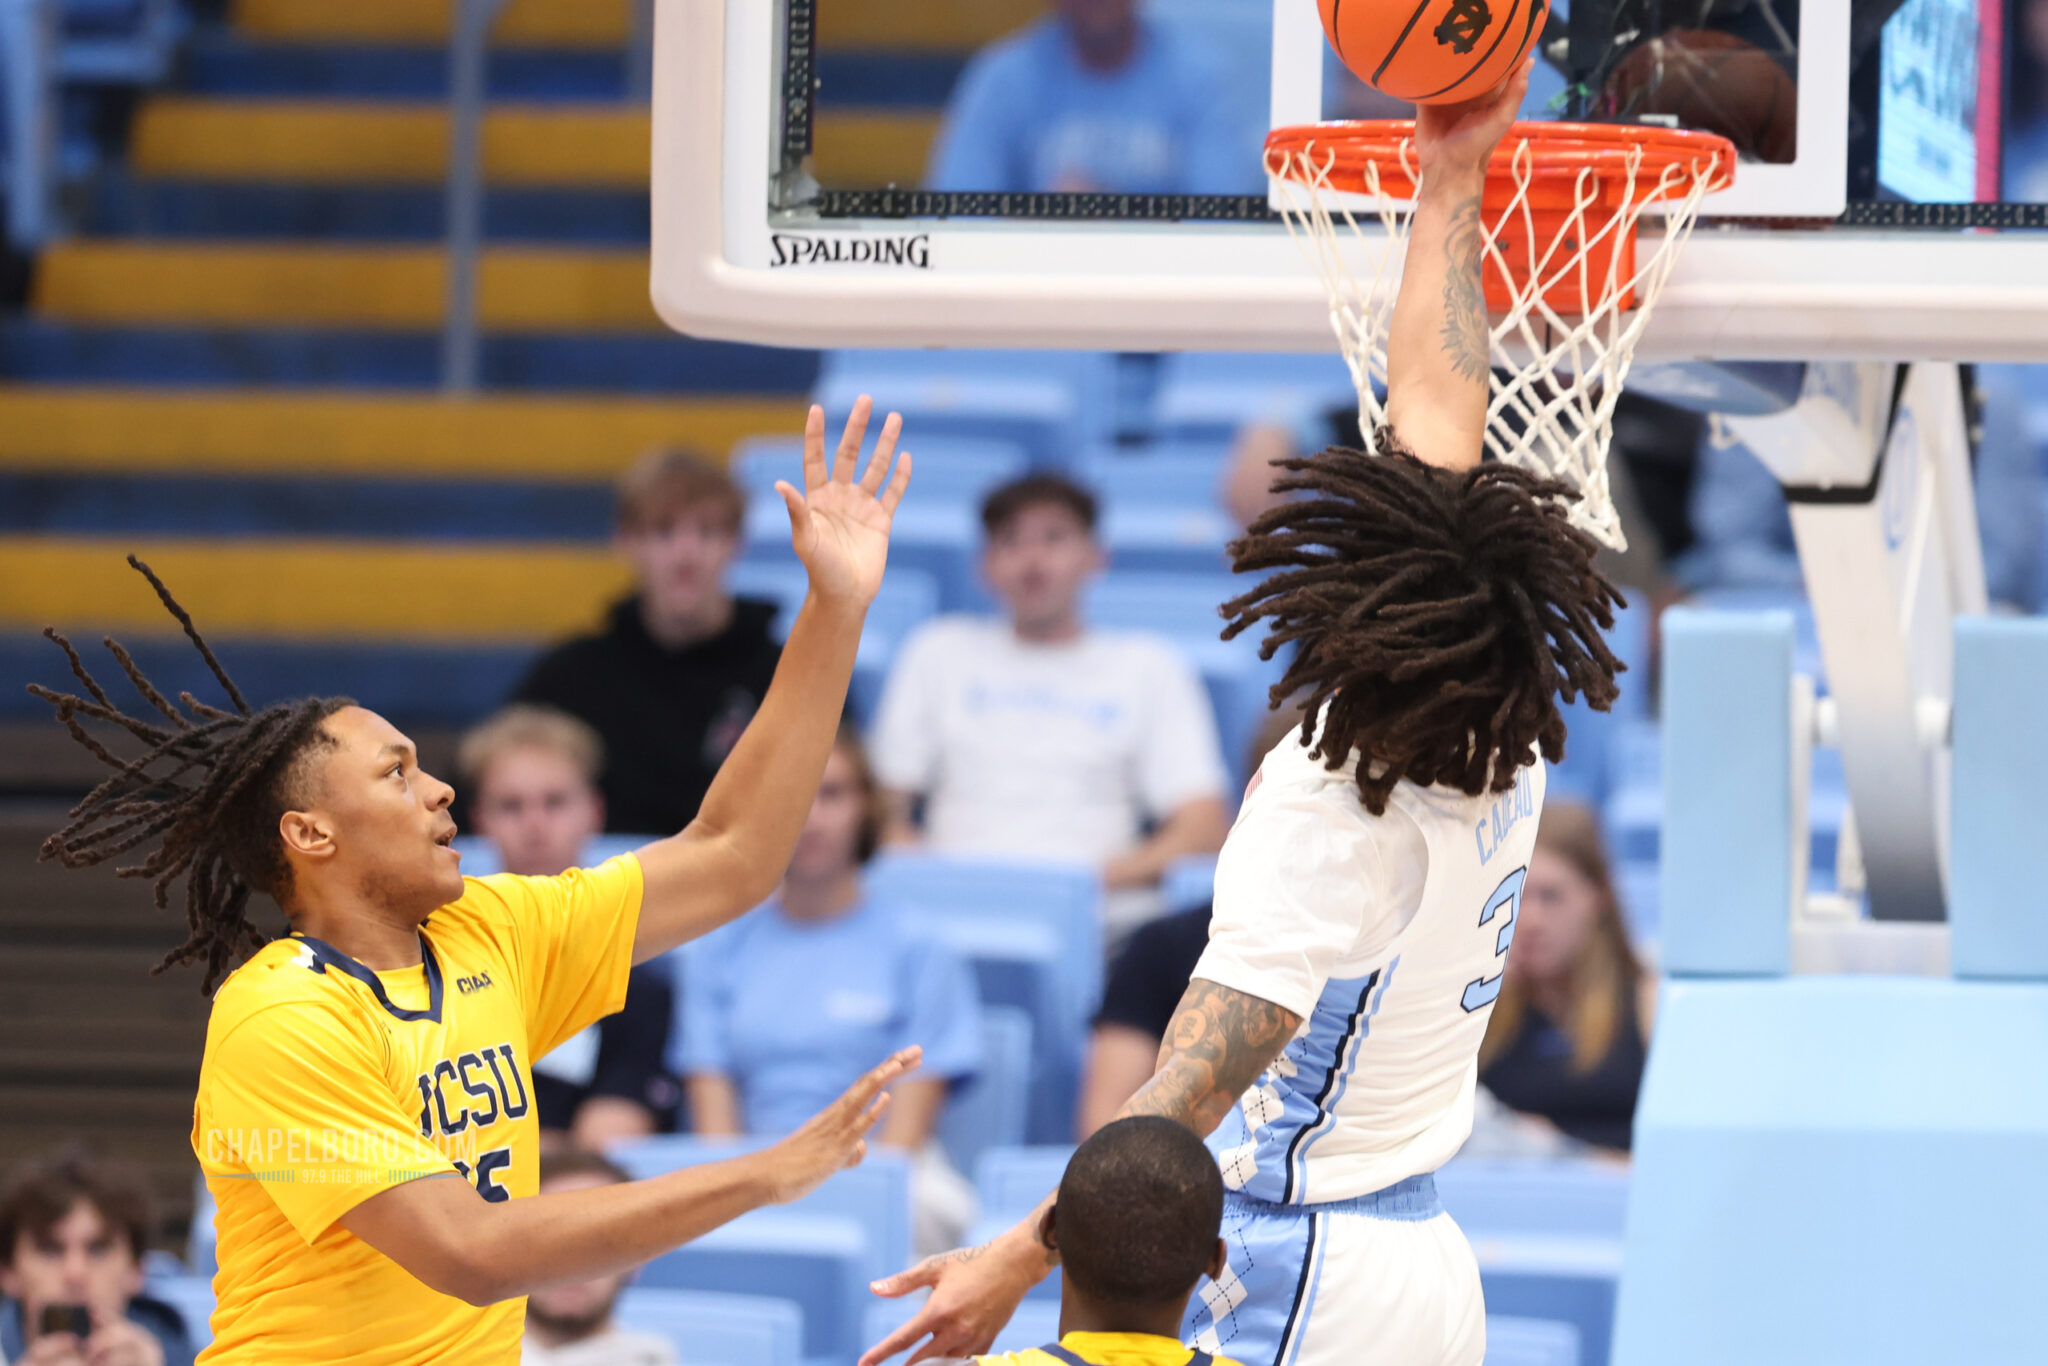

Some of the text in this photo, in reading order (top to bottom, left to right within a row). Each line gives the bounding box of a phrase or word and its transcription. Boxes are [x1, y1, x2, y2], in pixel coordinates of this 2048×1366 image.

[770, 233, 930, 269] SPALDING
[1460, 865, 1527, 1014] 3
[456, 971, 493, 995] CIAA
